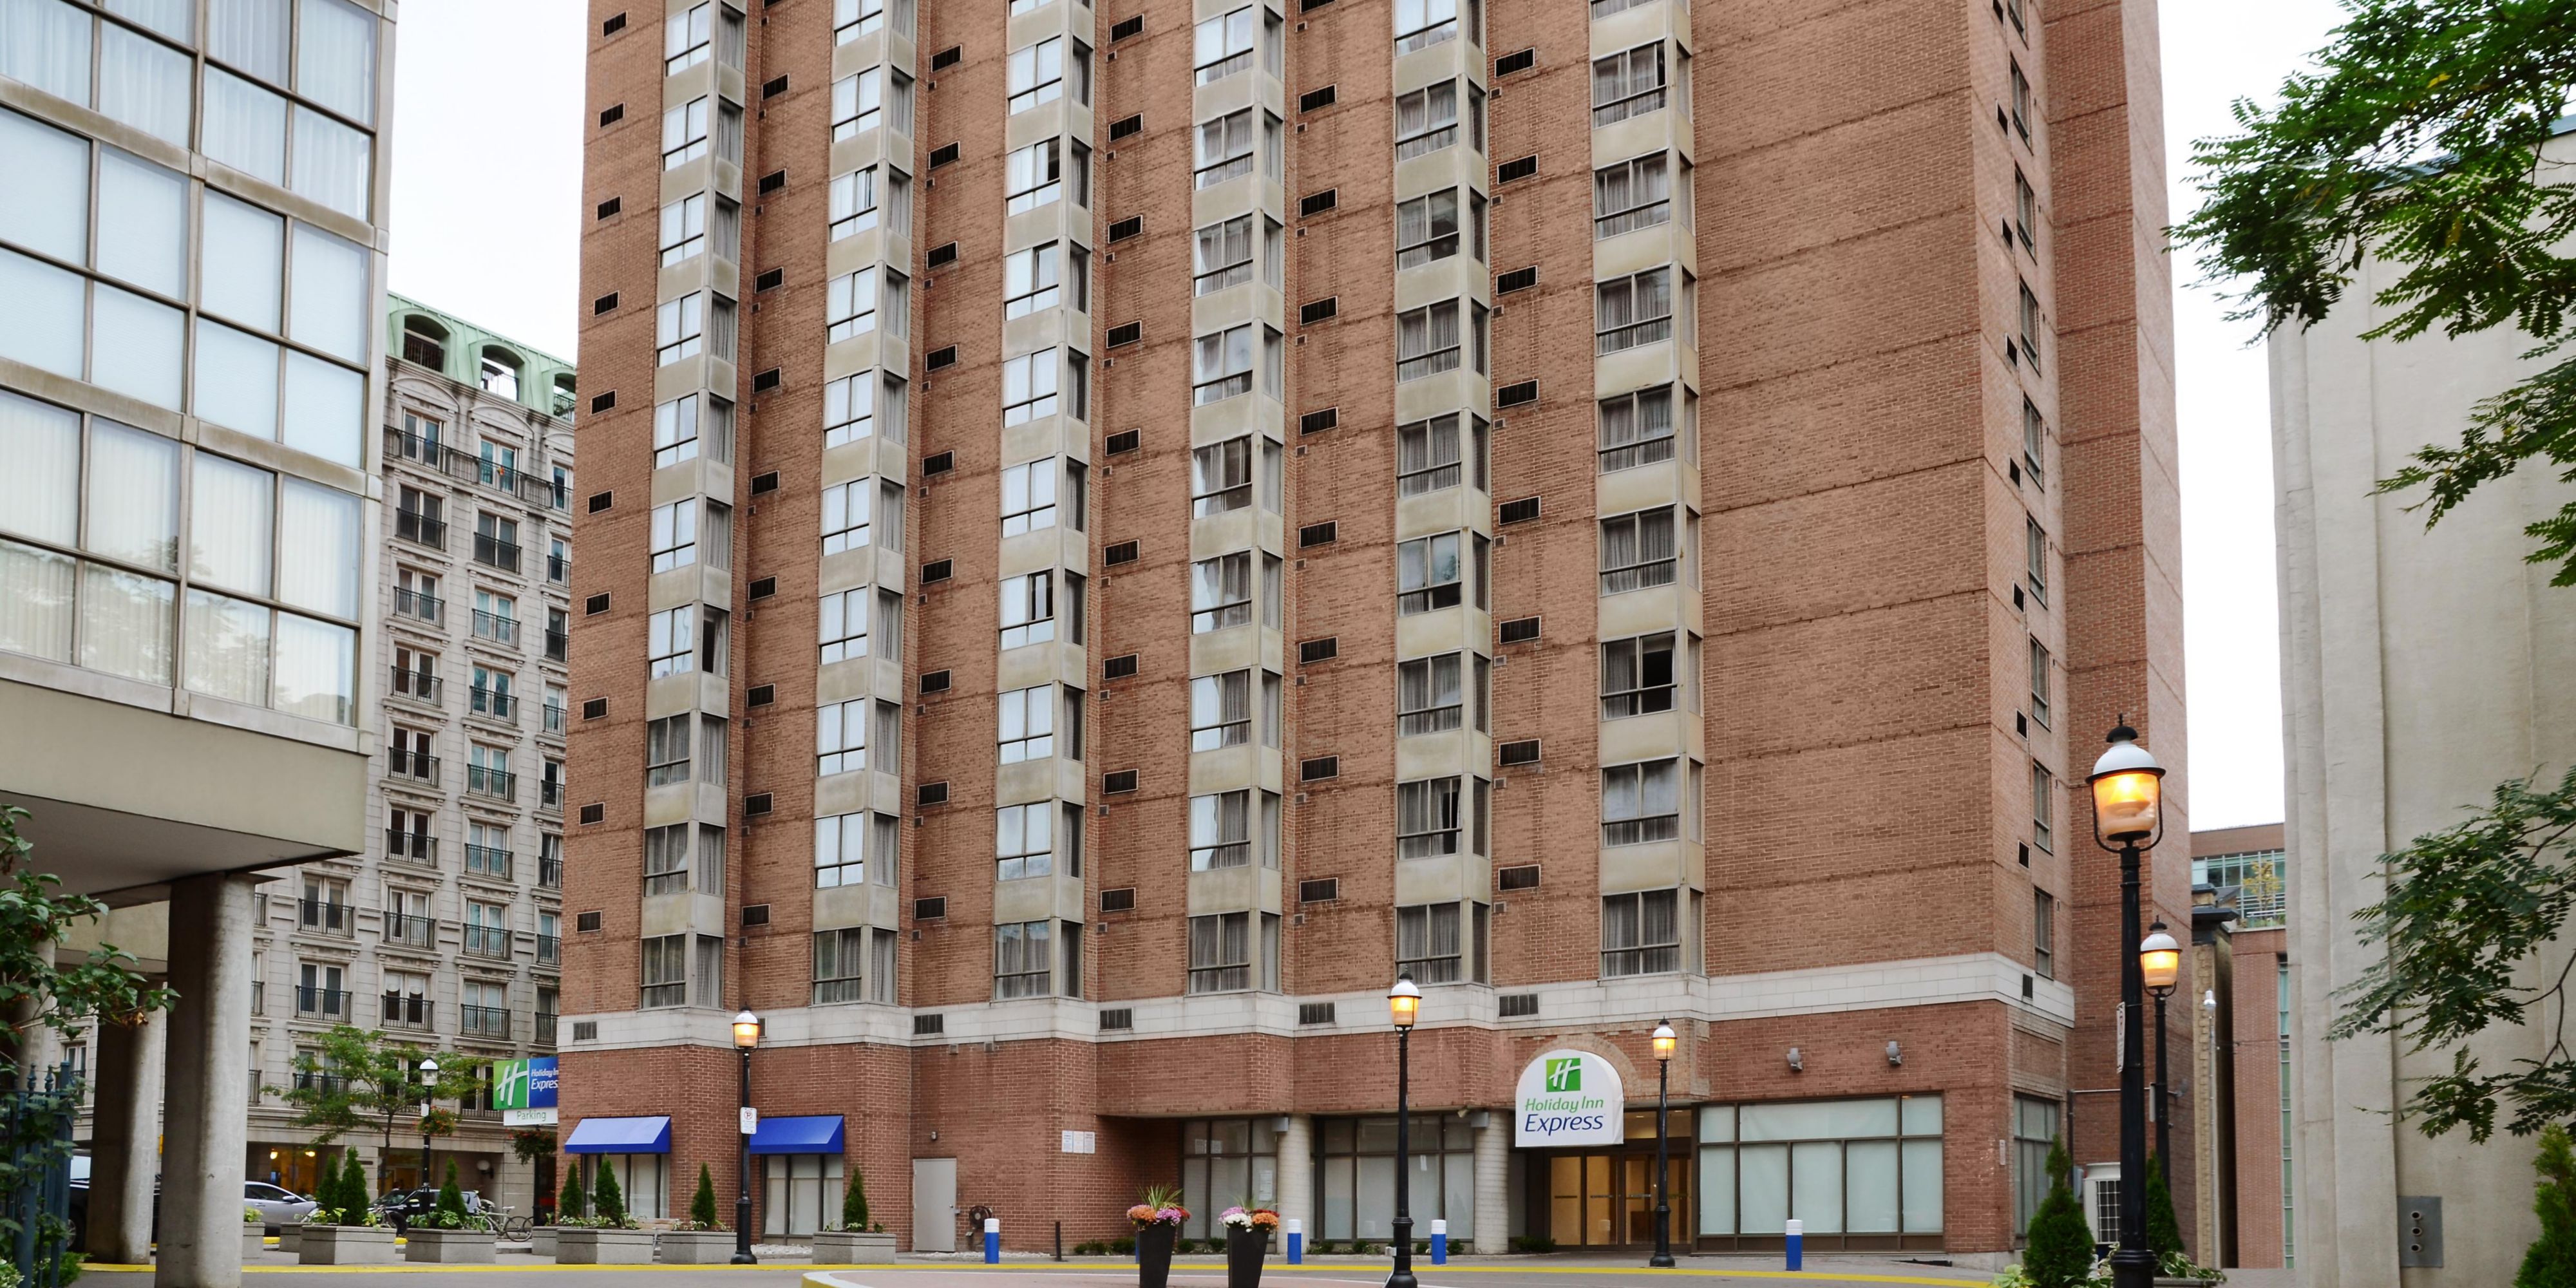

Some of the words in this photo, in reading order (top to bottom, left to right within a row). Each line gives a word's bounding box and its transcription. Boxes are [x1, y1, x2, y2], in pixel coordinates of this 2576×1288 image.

[531, 1068, 553, 1077] Holiday
[531, 1078, 558, 1092] Expres
[1525, 1097, 1579, 1113] Holiday
[1581, 1095, 1604, 1109] Inn
[516, 1109, 546, 1121] Parking
[1525, 1113, 1604, 1136] Express
